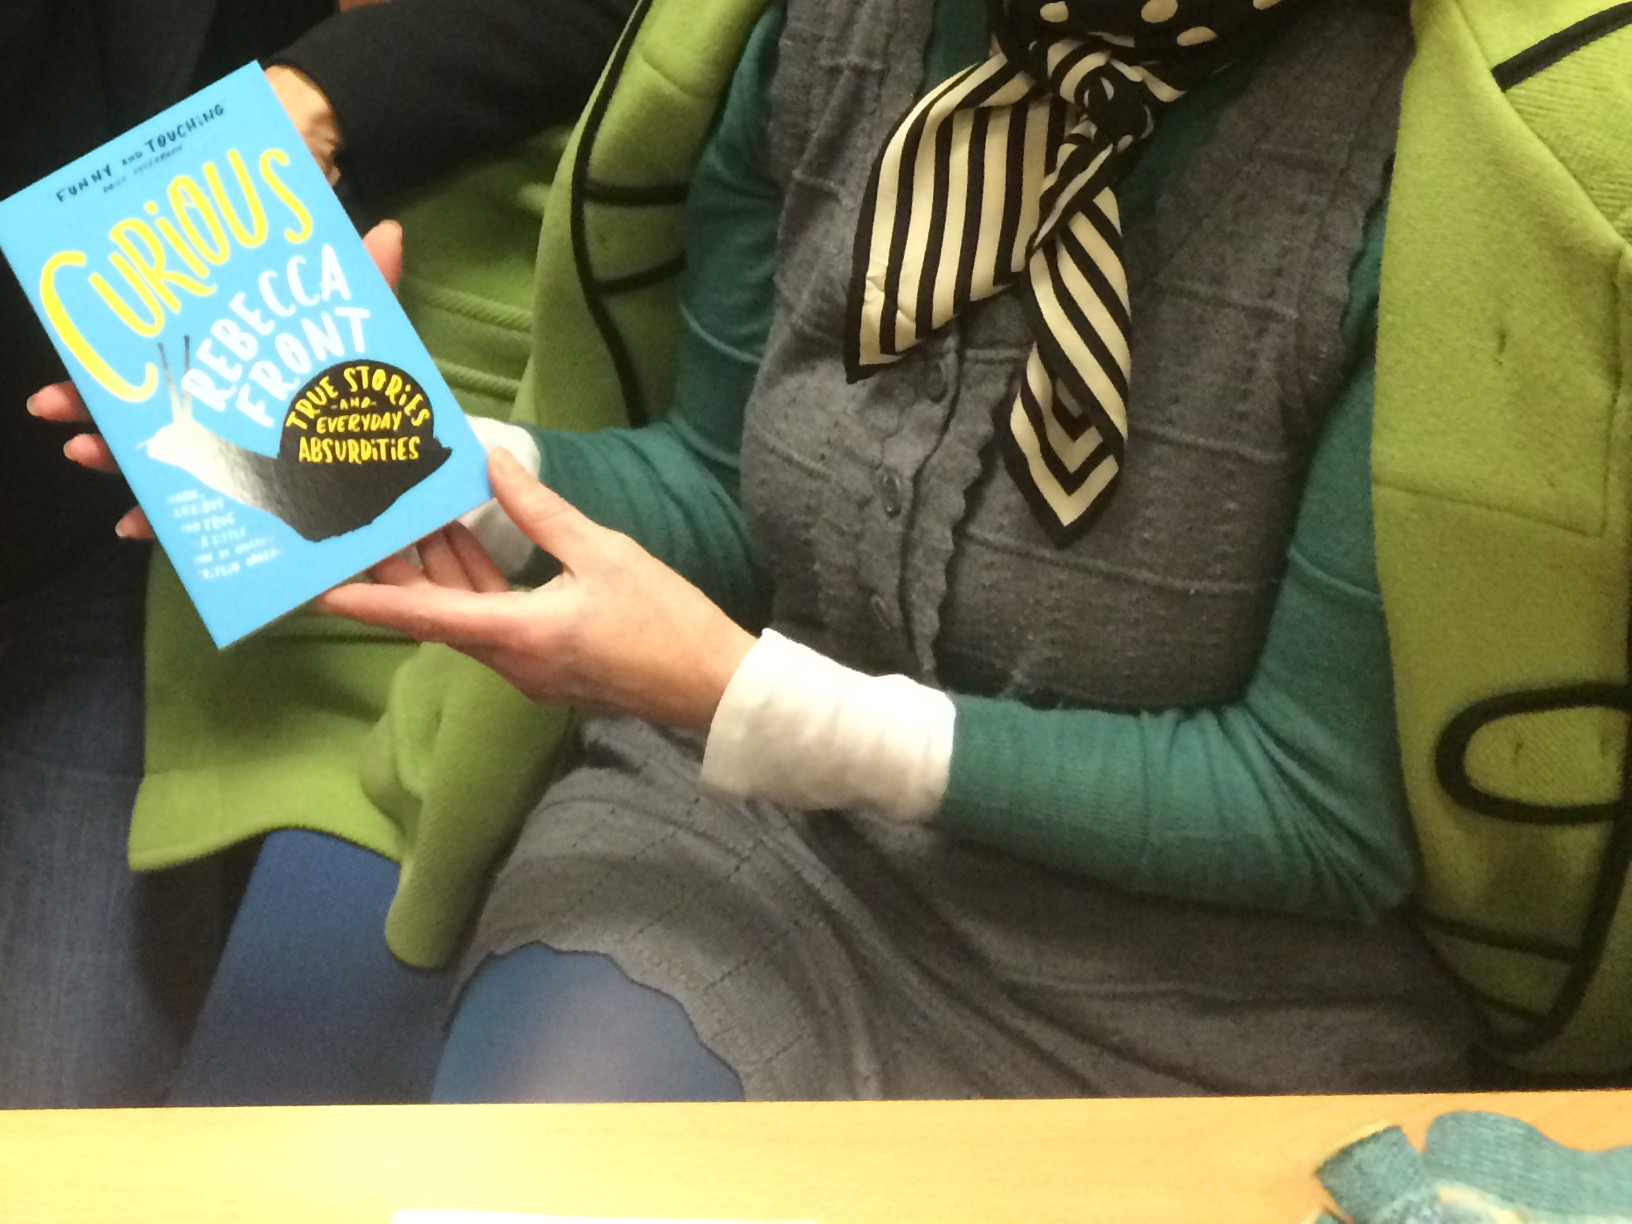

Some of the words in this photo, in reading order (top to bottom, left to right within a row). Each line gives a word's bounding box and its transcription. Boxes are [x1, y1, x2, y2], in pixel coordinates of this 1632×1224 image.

[56, 164, 112, 202] FUNNY
[122, 151, 143, 166] AND
[181, 243, 351, 411] REBECCA
[235, 306, 370, 427] FRONT
[285, 375, 339, 430] TRUE
[316, 411, 402, 434] EVERYDAY
